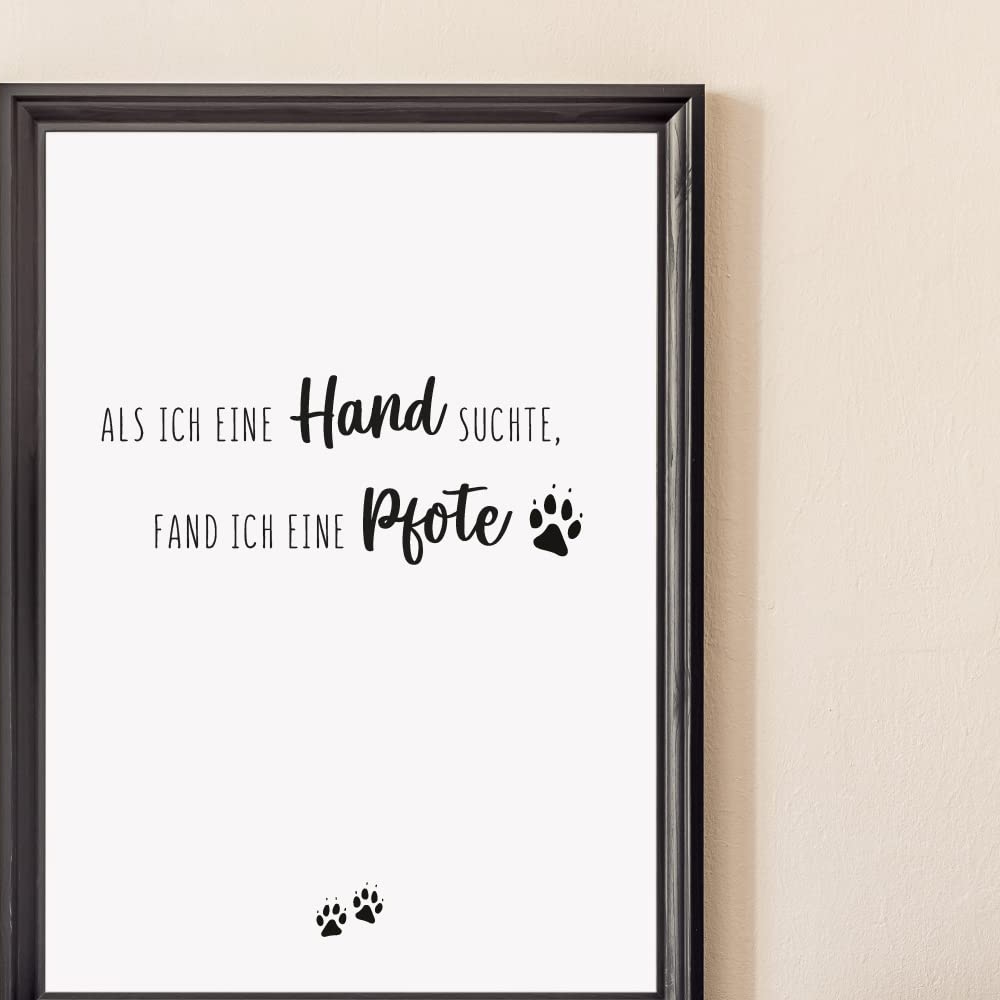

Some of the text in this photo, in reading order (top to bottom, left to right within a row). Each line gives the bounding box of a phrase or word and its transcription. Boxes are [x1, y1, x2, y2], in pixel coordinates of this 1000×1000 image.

[101, 374, 561, 450] ALS ICH EINE Hand SUCHTE,
[154, 482, 514, 566] FAND ICH EINE Pfote
